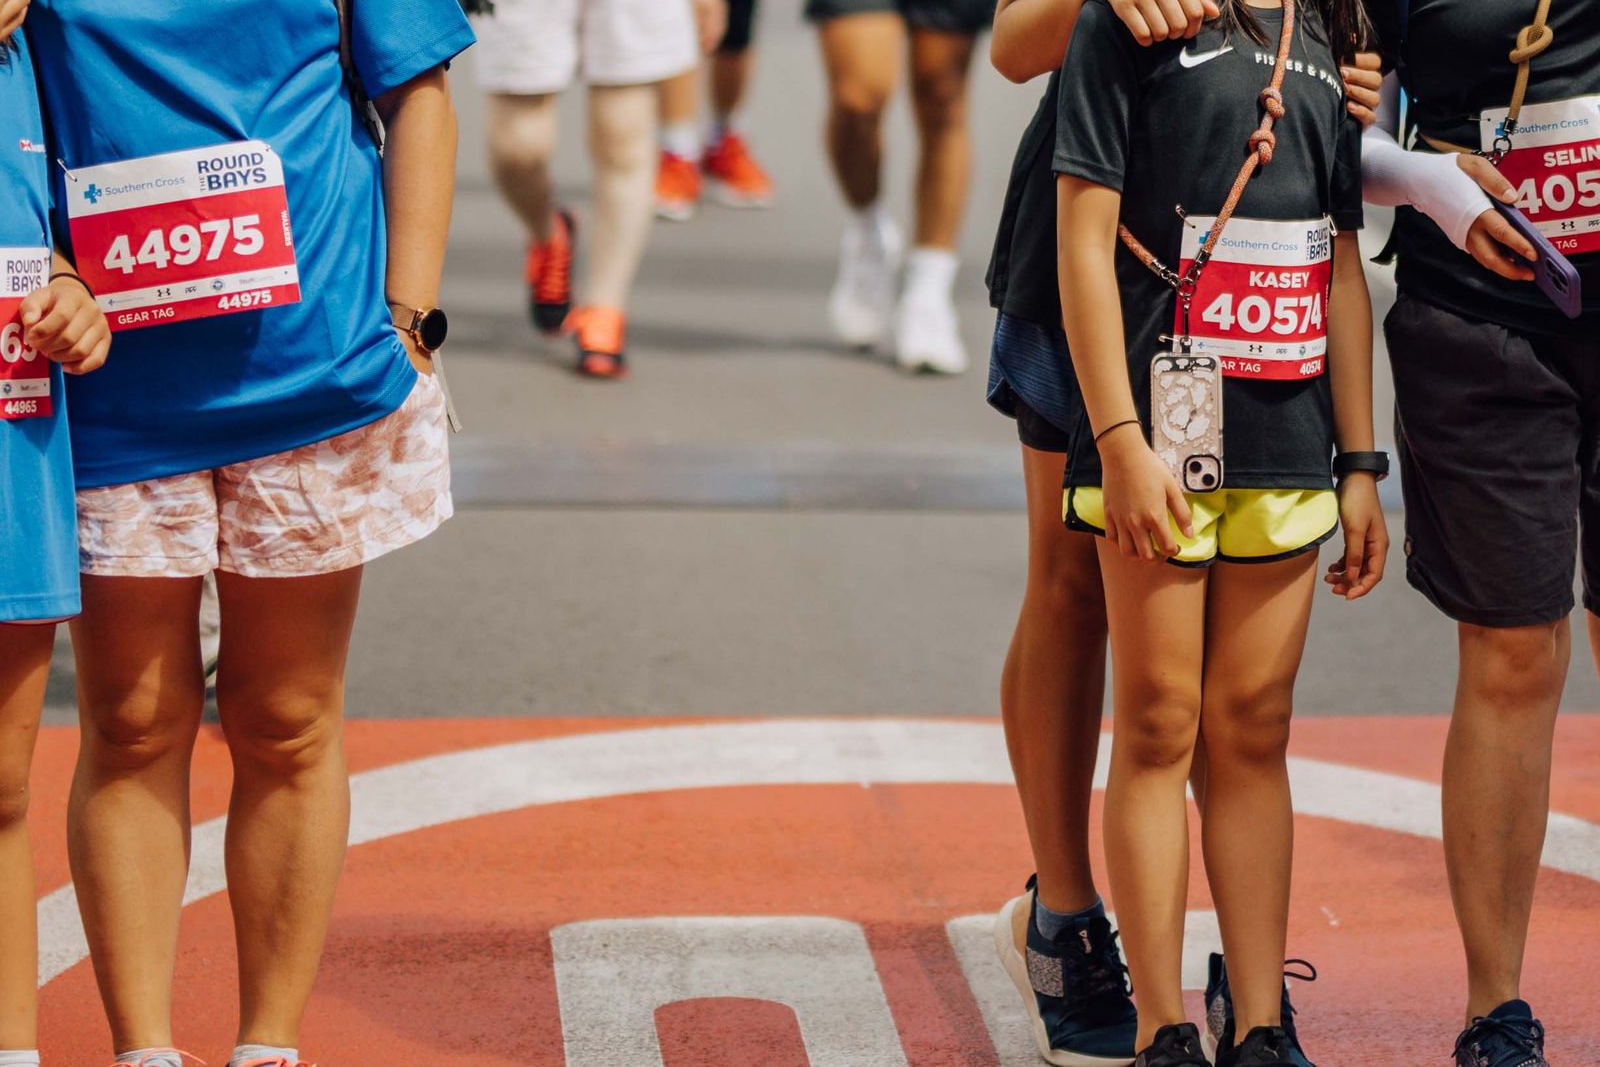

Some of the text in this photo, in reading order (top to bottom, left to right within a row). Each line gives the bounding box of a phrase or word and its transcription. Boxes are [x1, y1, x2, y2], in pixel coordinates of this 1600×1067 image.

[1255, 52, 1303, 73] FISER
[1514, 117, 1589, 135] Southern Cross
[197, 152, 263, 174] ROUND
[105, 174, 185, 196] Southern Cross
[207, 167, 267, 191] BAYS
[103, 214, 265, 274] 44975
[1221, 237, 1298, 251] Southern Cross
[1307, 226, 1328, 244] ROUND
[1556, 239, 1578, 249] TAG
[1309, 243, 1328, 260] BAYS
[7, 260, 42, 273] ROUND
[12, 275, 41, 292] BAYS
[1249, 271, 1310, 289] KASEY
[217, 289, 272, 310] 44975
[117, 307, 175, 325] GEAR TAG
[1202, 292, 1322, 334] 40574
[1239, 362, 1262, 373] TAG
[1300, 360, 1321, 375] 40574
[4, 400, 37, 414] 44965
